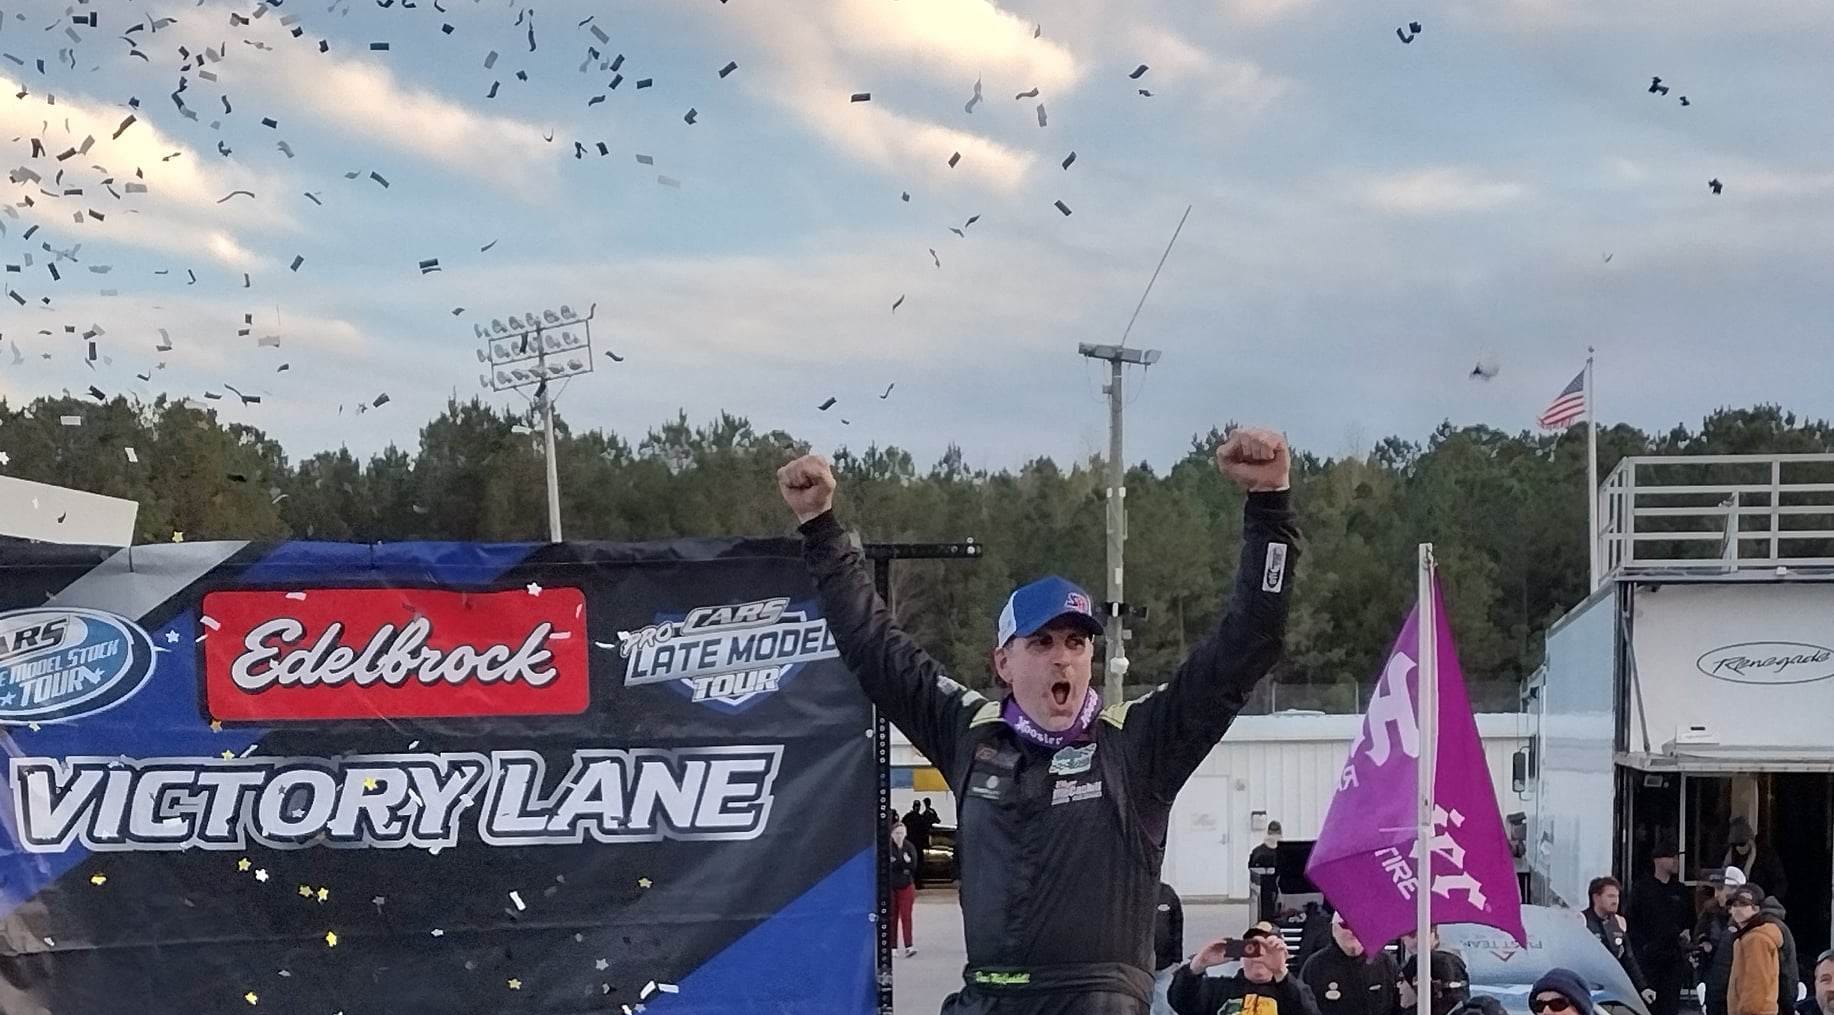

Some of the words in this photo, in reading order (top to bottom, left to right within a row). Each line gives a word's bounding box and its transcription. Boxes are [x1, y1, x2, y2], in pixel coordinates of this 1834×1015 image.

[684, 599, 787, 633] CARS
[0, 619, 67, 657] RS
[231, 617, 556, 691] Edelbrock
[621, 622, 673, 656] PRO
[631, 638, 721, 678] LATE
[726, 626, 836, 666] MODEL
[9, 656, 62, 684] MODEL
[66, 640, 119, 668] STOCK
[1713, 650, 1831, 676] Renegade
[19, 665, 86, 707] TOUR
[692, 668, 778, 701] TOUR
[1014, 716, 1064, 745] Hoosier
[14, 755, 489, 850] VICTORY
[481, 748, 783, 844] LANE
